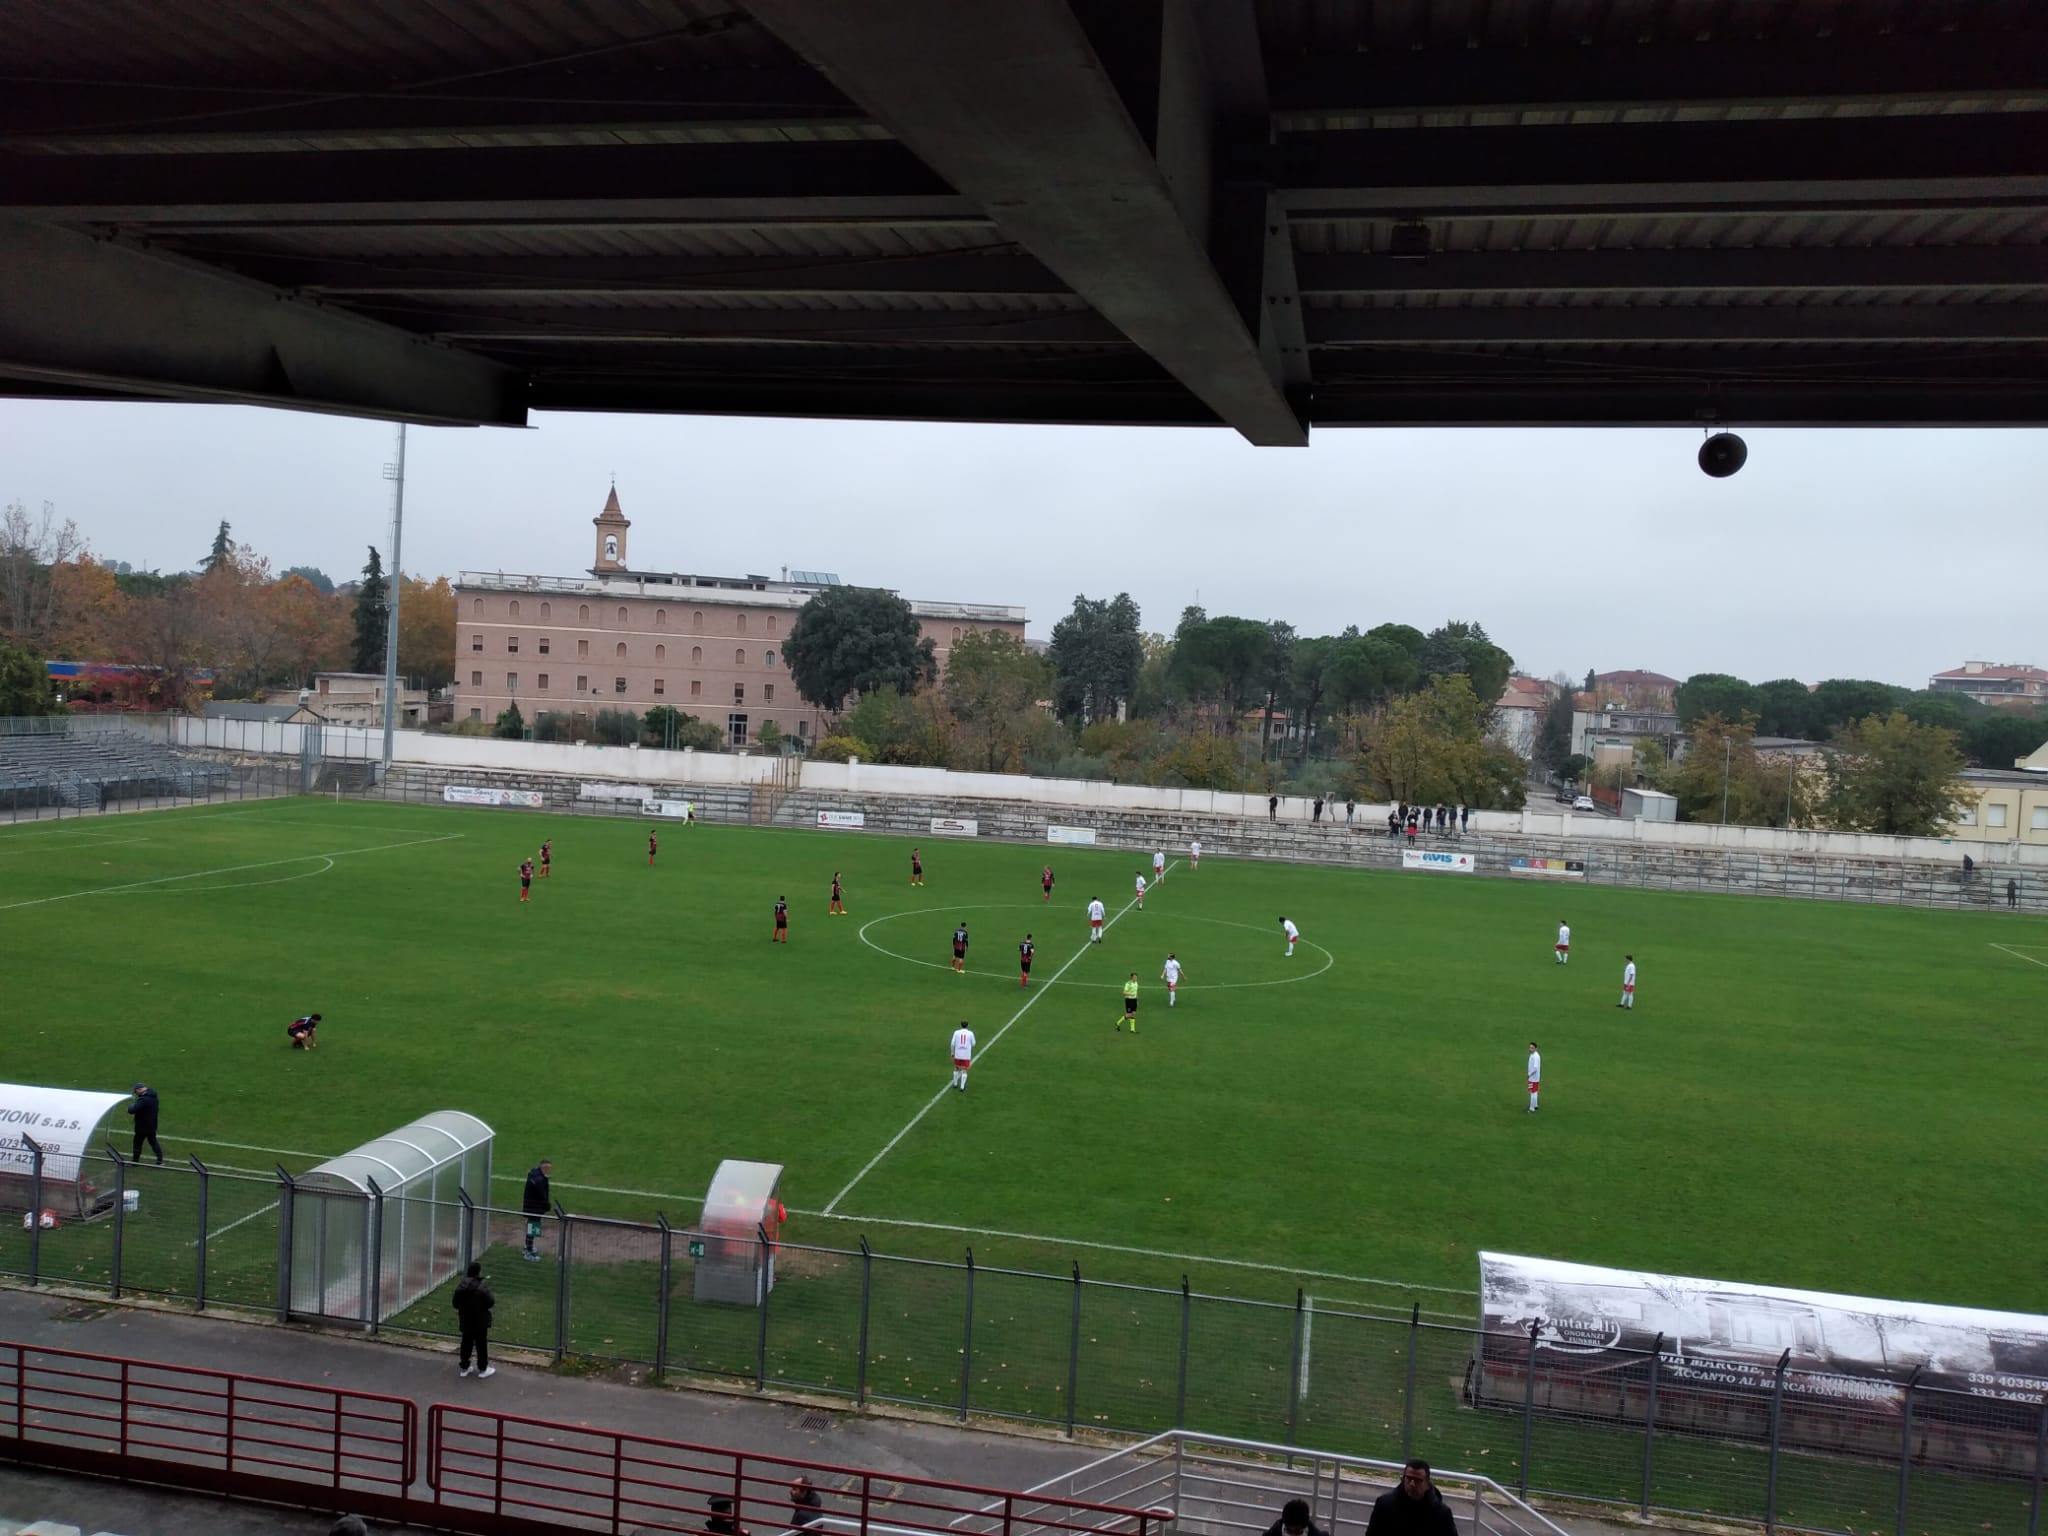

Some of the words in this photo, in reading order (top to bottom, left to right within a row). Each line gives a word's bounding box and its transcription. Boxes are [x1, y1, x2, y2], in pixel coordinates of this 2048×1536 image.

[960, 1034, 967, 1045] 11
[41, 1117, 81, 1130] s.a.s.
[1563, 1329, 1606, 1340] ONORANZE
[1660, 1355, 1685, 1365] VIA
[1968, 1372, 1994, 1384] 339
[1674, 1367, 1736, 1383] ACCANTO
[1738, 1376, 1756, 1386] AL
[1848, 1390, 1876, 1401] UNO
[1970, 1387, 1995, 1398] 333
